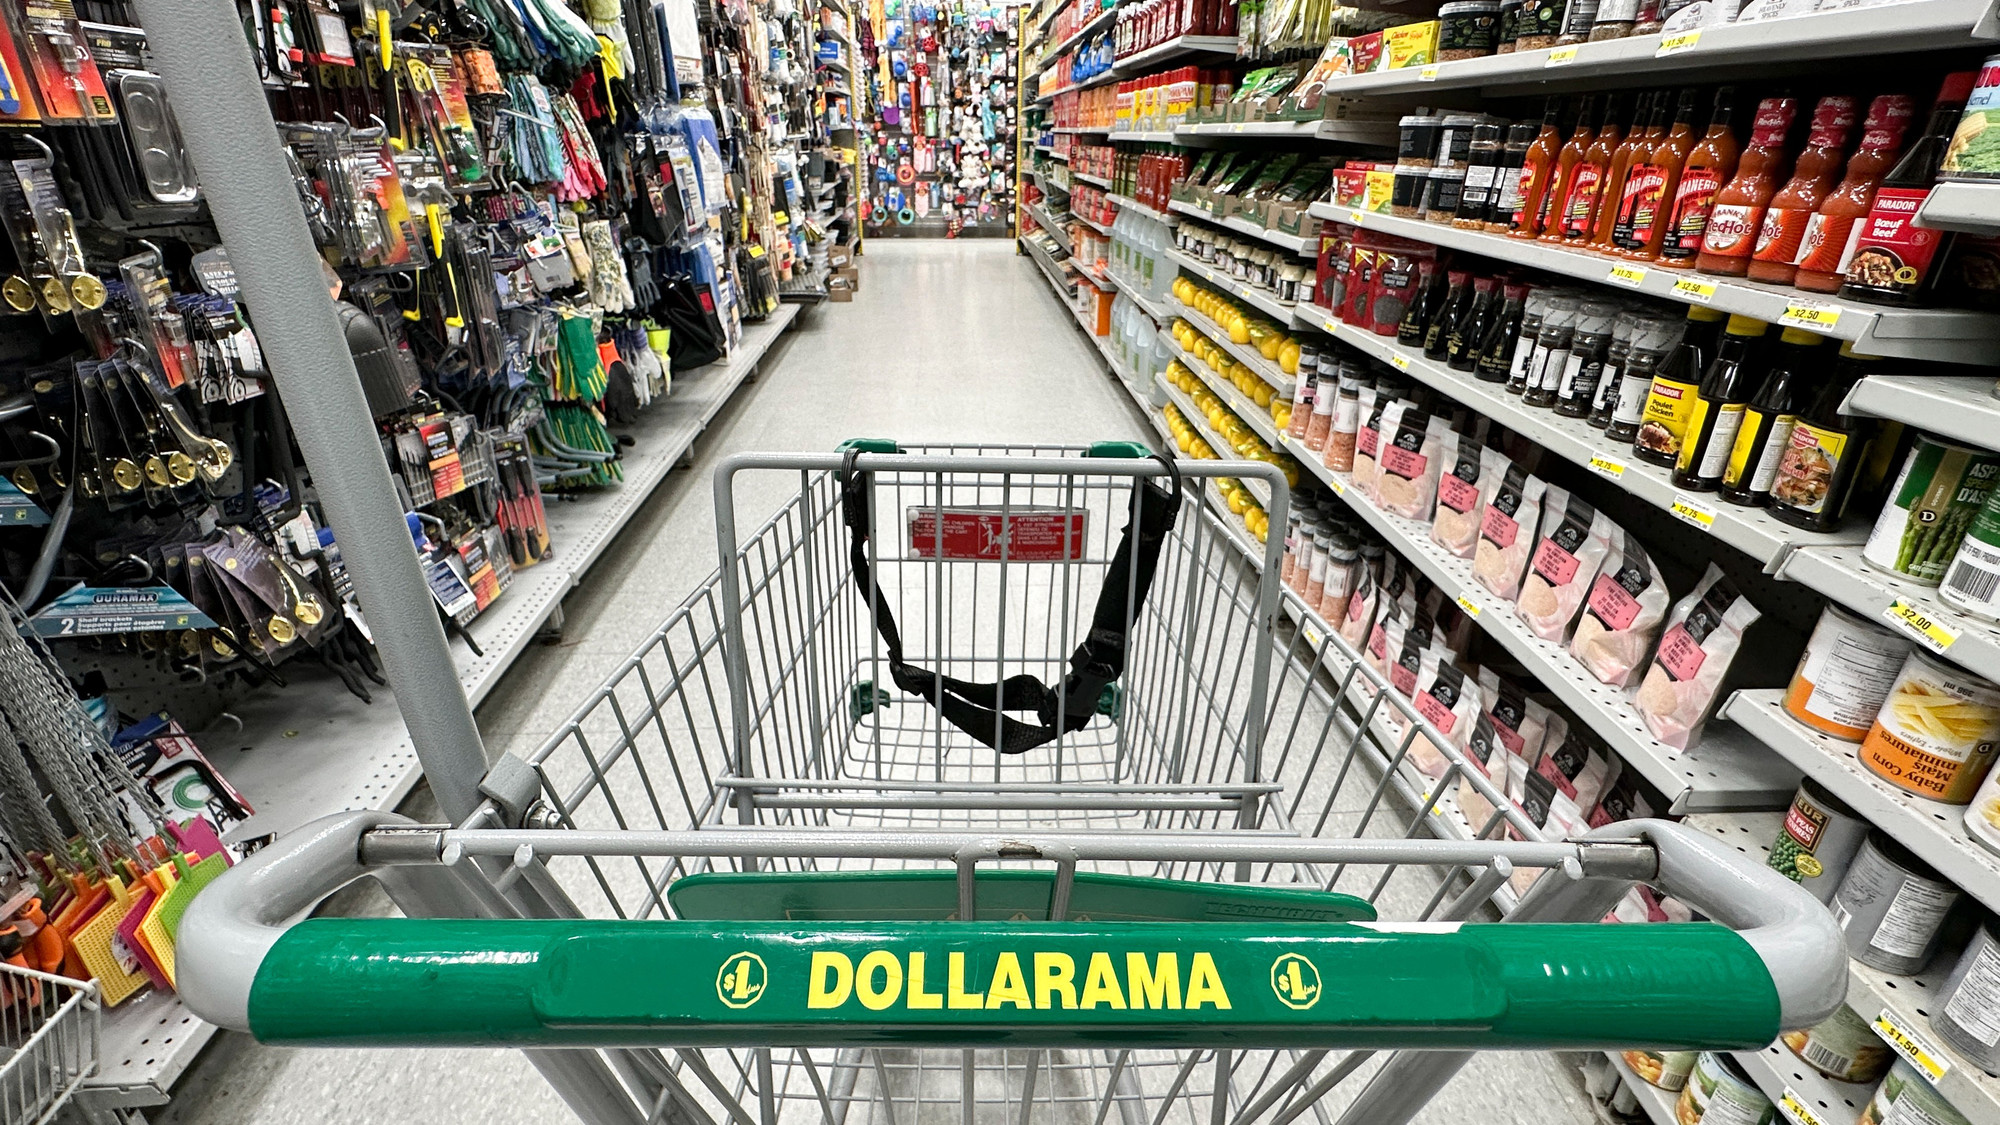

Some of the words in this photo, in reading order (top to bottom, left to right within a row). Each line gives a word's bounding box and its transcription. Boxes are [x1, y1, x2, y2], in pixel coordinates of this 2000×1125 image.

[1877, 199, 1917, 211] PARADOR
[1707, 219, 1753, 235] RedHot
[1872, 227, 1900, 238] Beef
[1682, 282, 1701, 292] $2.50
[1794, 309, 1820, 320] $2.50
[1653, 384, 1680, 398] PARADOR
[1649, 405, 1674, 417] Chicken
[1652, 399, 1673, 410] Poulet
[1596, 460, 1612, 470] $2.75
[1679, 505, 1699, 518] $2.75
[1921, 511, 1936, 520] D
[95, 594, 155, 603] DURAMAX
[60, 618, 75, 635] 2
[1901, 608, 1932, 630] $2.00
[1879, 731, 1958, 772] miniatures
[1872, 751, 1903, 776] Corn
[1913, 760, 1953, 783] Maïs
[1903, 772, 1947, 793] Baby
[723, 960, 751, 999] $1
[807, 950, 1233, 1011] DOLLARAMA
[1277, 961, 1308, 1001] $1
[1888, 1027, 1919, 1056] $1.50
[1793, 1105, 1821, 1125] $1.50
